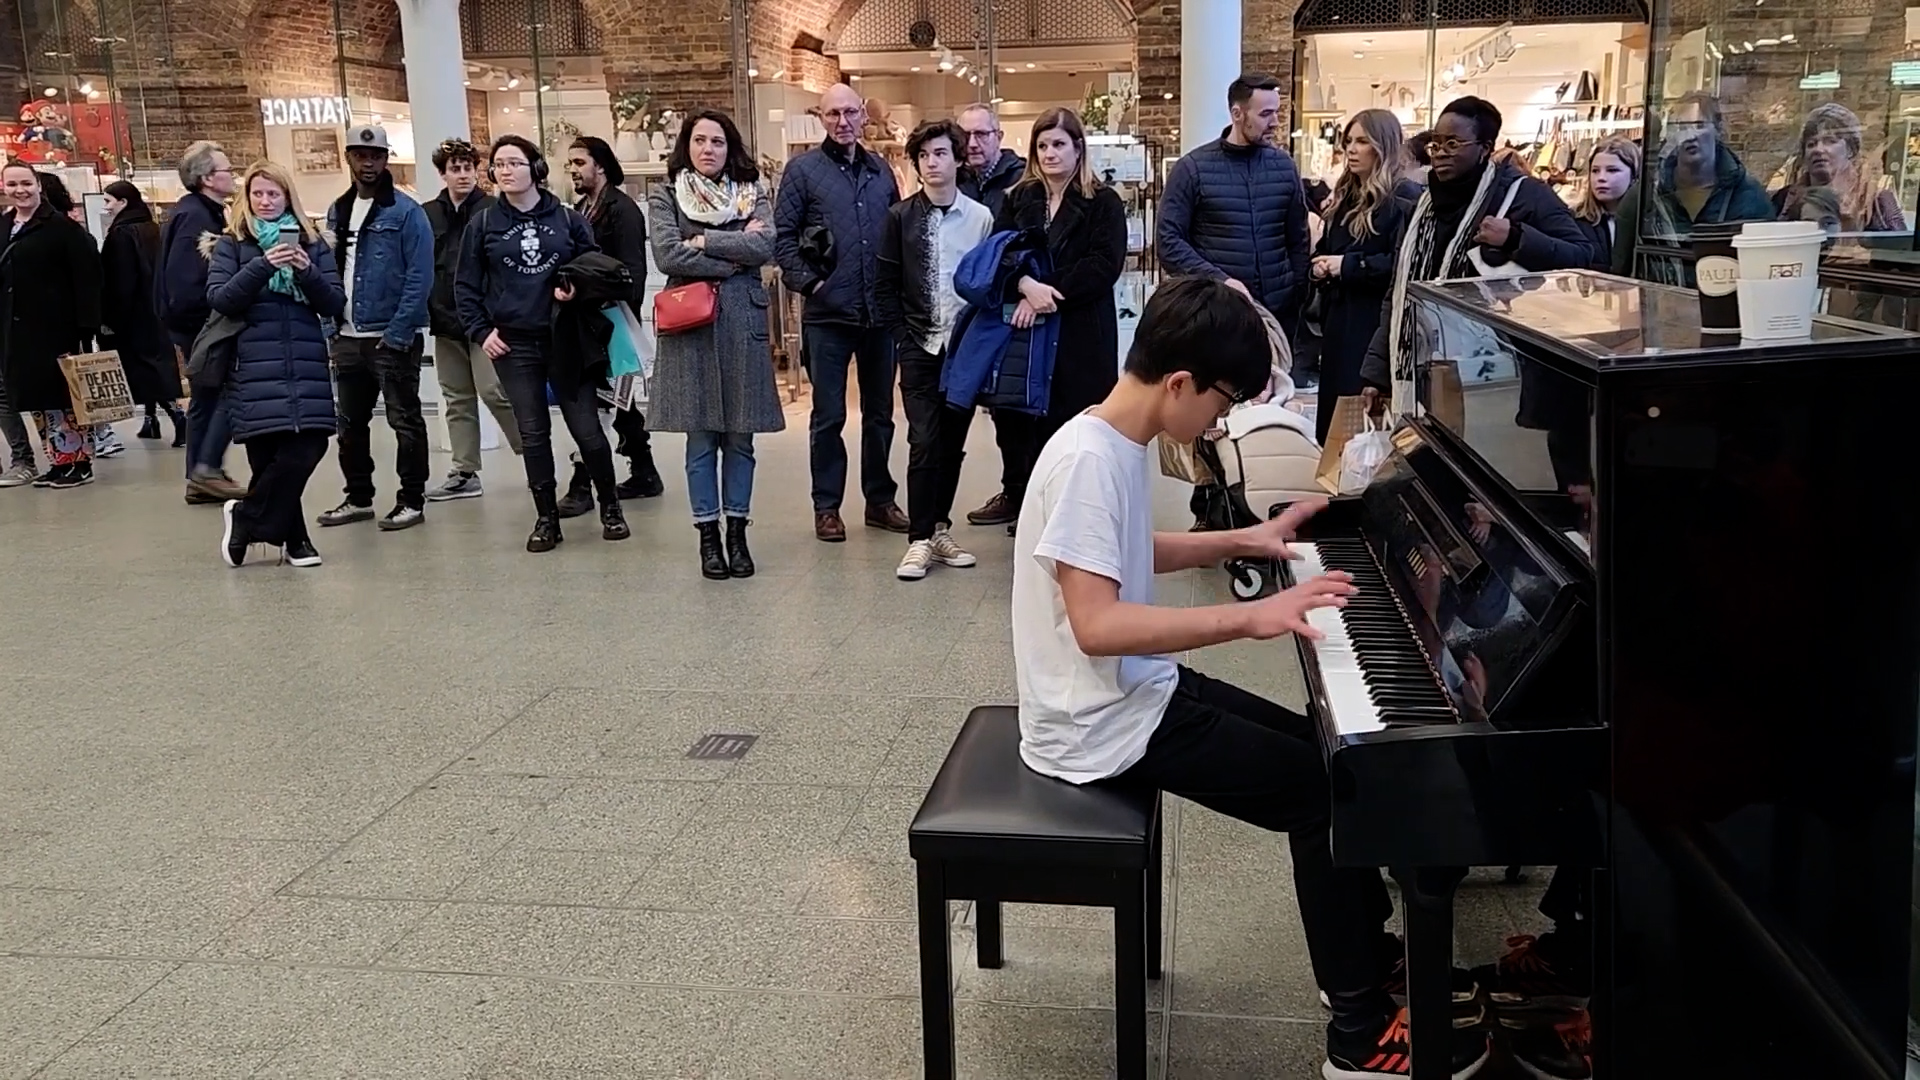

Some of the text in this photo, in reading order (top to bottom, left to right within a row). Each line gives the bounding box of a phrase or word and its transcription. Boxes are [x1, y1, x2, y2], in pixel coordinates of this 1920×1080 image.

[502, 221, 556, 240] UNIVERTY
[503, 252, 560, 274] OF TORONTO
[1699, 268, 1739, 280] PAUL
[85, 369, 124, 386] DEATH
[89, 383, 128, 399] EATER
